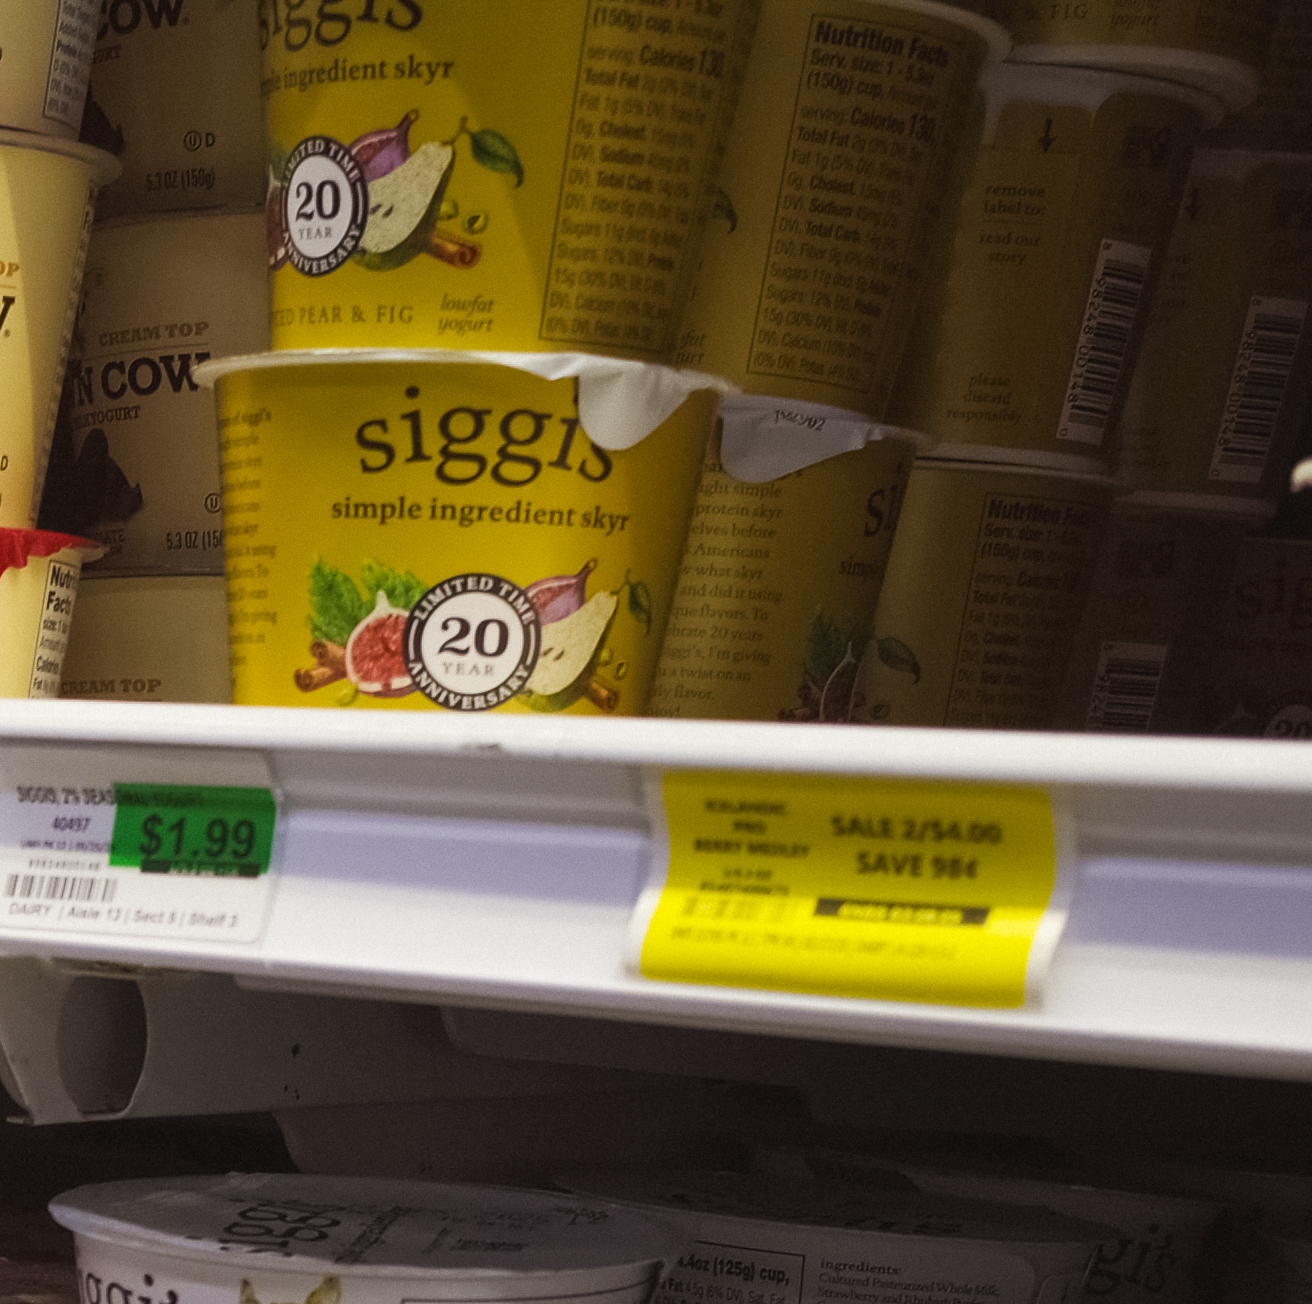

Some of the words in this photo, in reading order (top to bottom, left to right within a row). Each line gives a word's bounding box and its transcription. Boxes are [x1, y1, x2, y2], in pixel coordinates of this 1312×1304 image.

[815, 21, 905, 57] Nutrition
[394, 57, 454, 85] skyr
[295, 180, 341, 223] 20
[377, 305, 414, 324] FIG
[332, 498, 422, 523] simple
[430, 498, 574, 527] ingredient
[581, 506, 630, 532] skyr
[438, 618, 509, 658] 20
[443, 661, 495, 678] YEAR
[139, 813, 257, 860] $1.99
[831, 814, 897, 838] SALE
[856, 851, 924, 878] SAVE
